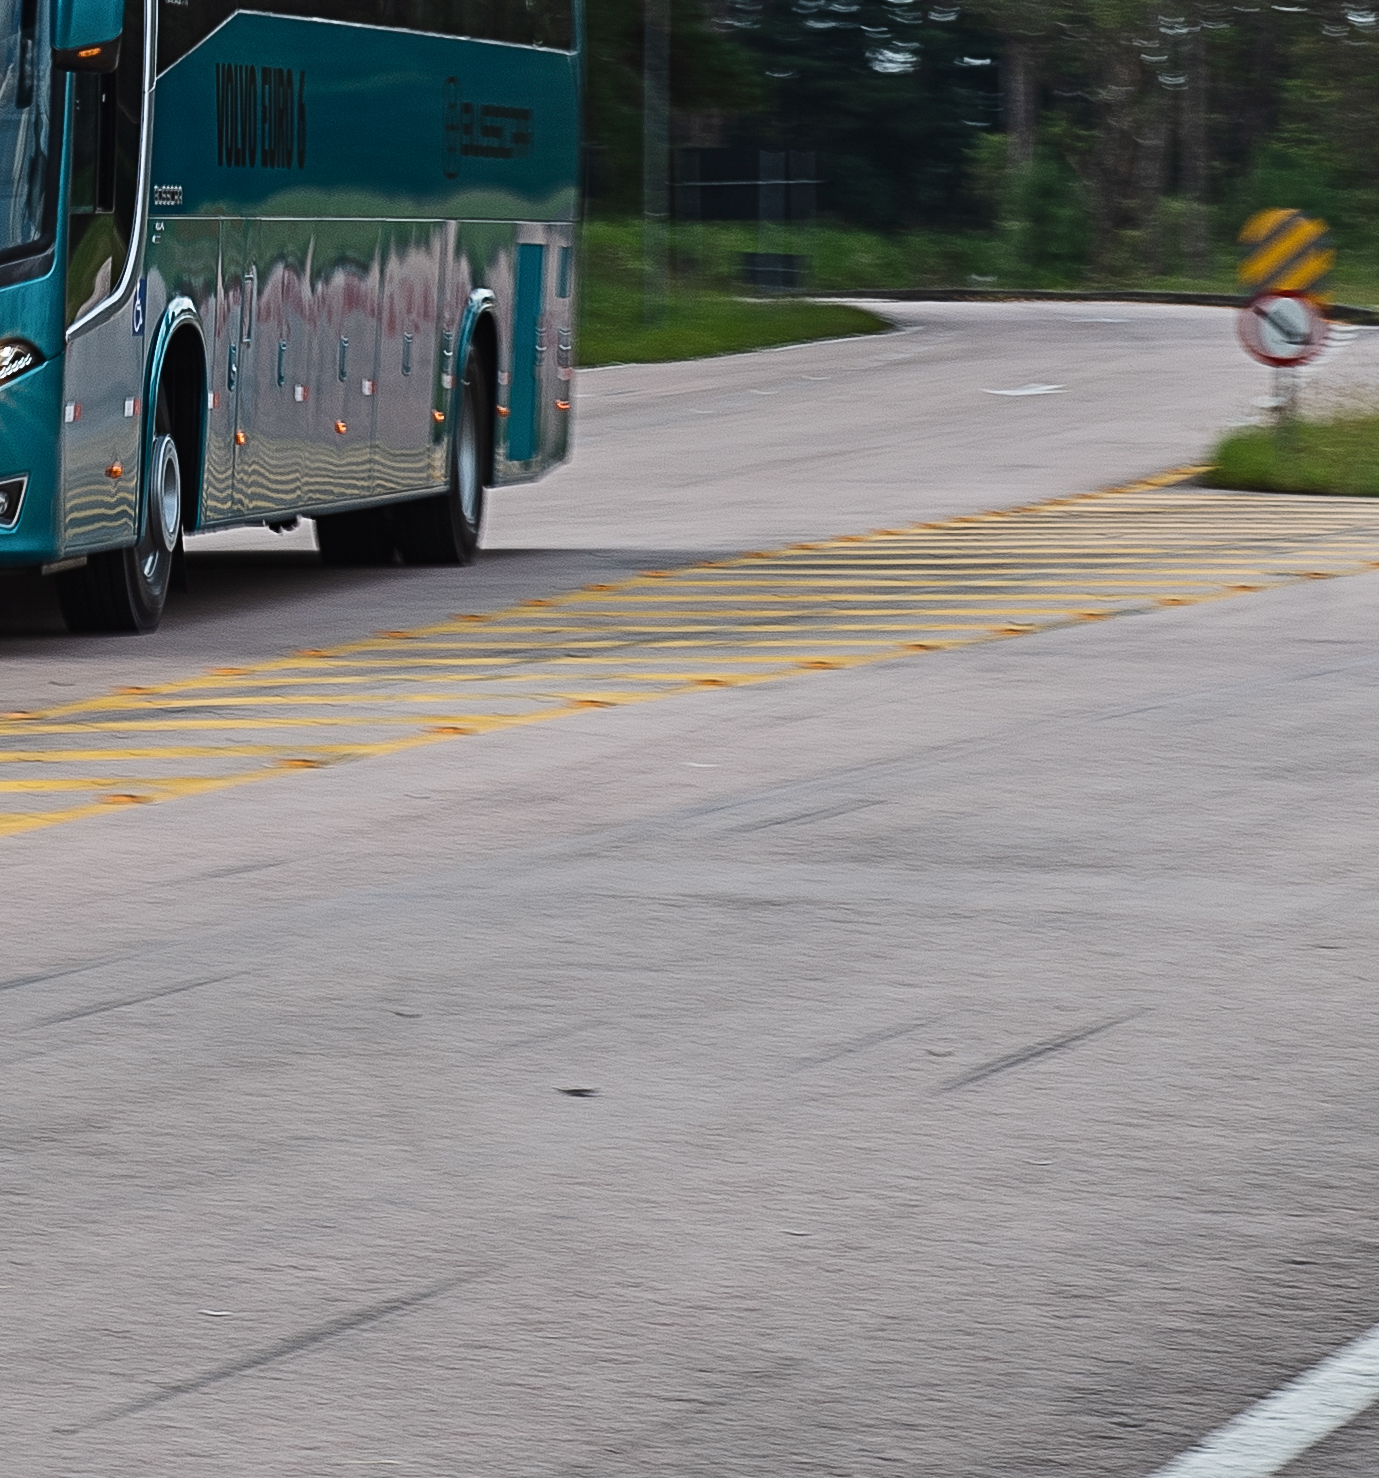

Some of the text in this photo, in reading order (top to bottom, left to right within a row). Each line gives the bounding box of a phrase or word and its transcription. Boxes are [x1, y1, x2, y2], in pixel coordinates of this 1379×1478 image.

[215, 62, 307, 170] VOLVO EURO 6
